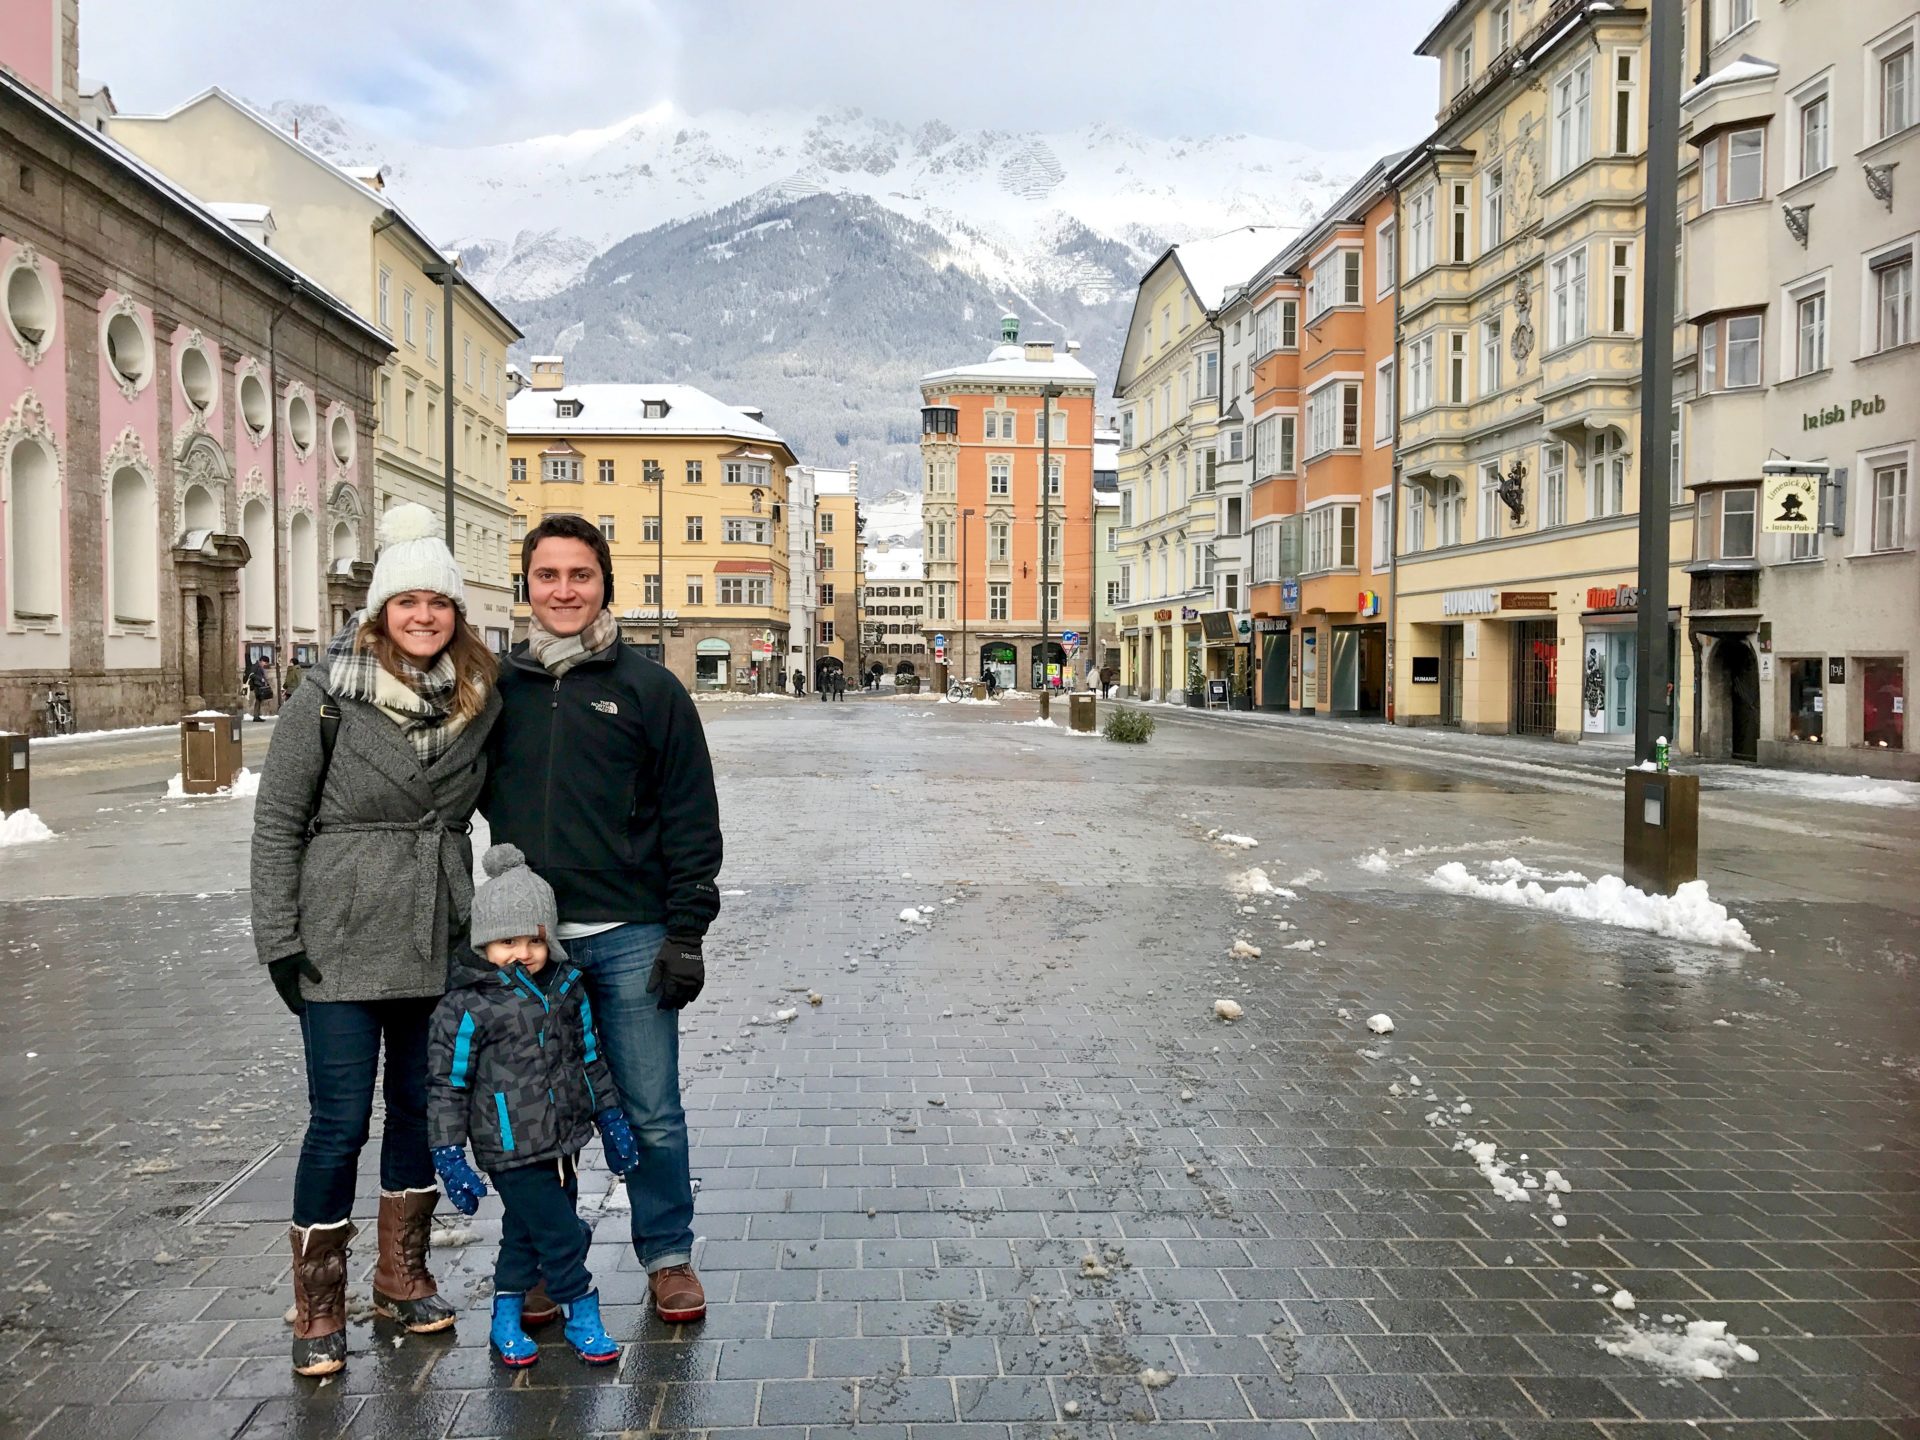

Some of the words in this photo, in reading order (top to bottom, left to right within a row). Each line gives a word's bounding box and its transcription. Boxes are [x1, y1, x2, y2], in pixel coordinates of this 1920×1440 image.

[1803, 404, 1845, 431] Irish
[1851, 394, 1886, 419] Pub
[1442, 588, 1499, 616] HUMANIC
